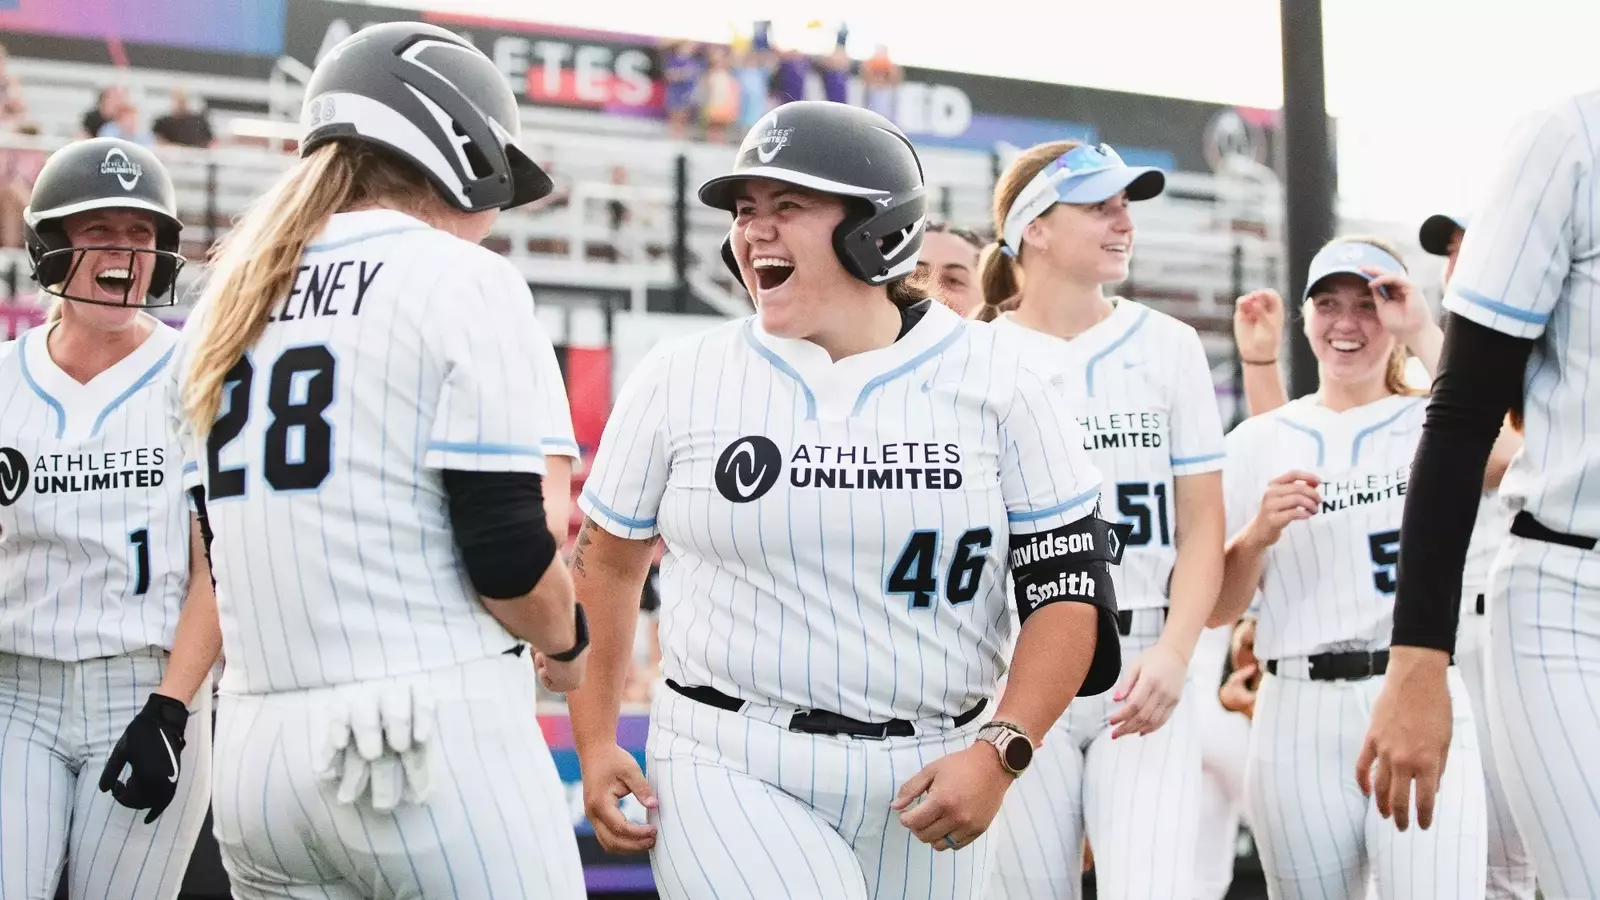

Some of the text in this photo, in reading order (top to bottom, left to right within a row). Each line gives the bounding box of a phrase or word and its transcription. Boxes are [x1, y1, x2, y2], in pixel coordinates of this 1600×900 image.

[268, 260, 384, 323] ENEY
[206, 340, 339, 502] 28
[1075, 412, 1160, 431] HLETES
[790, 442, 961, 465] ATHLETES
[1083, 432, 1161, 450] LIMITED
[34, 447, 164, 472] ATHLETES
[34, 469, 164, 494] UNLIMITED
[790, 467, 963, 490] UNLIMITED
[1320, 462, 1415, 497] THLETE
[1115, 481, 1170, 547] 51
[1322, 481, 1407, 515] NLIMITE
[127, 527, 150, 596] 1
[884, 526, 993, 610] 46
[1026, 571, 1096, 610] Smith
